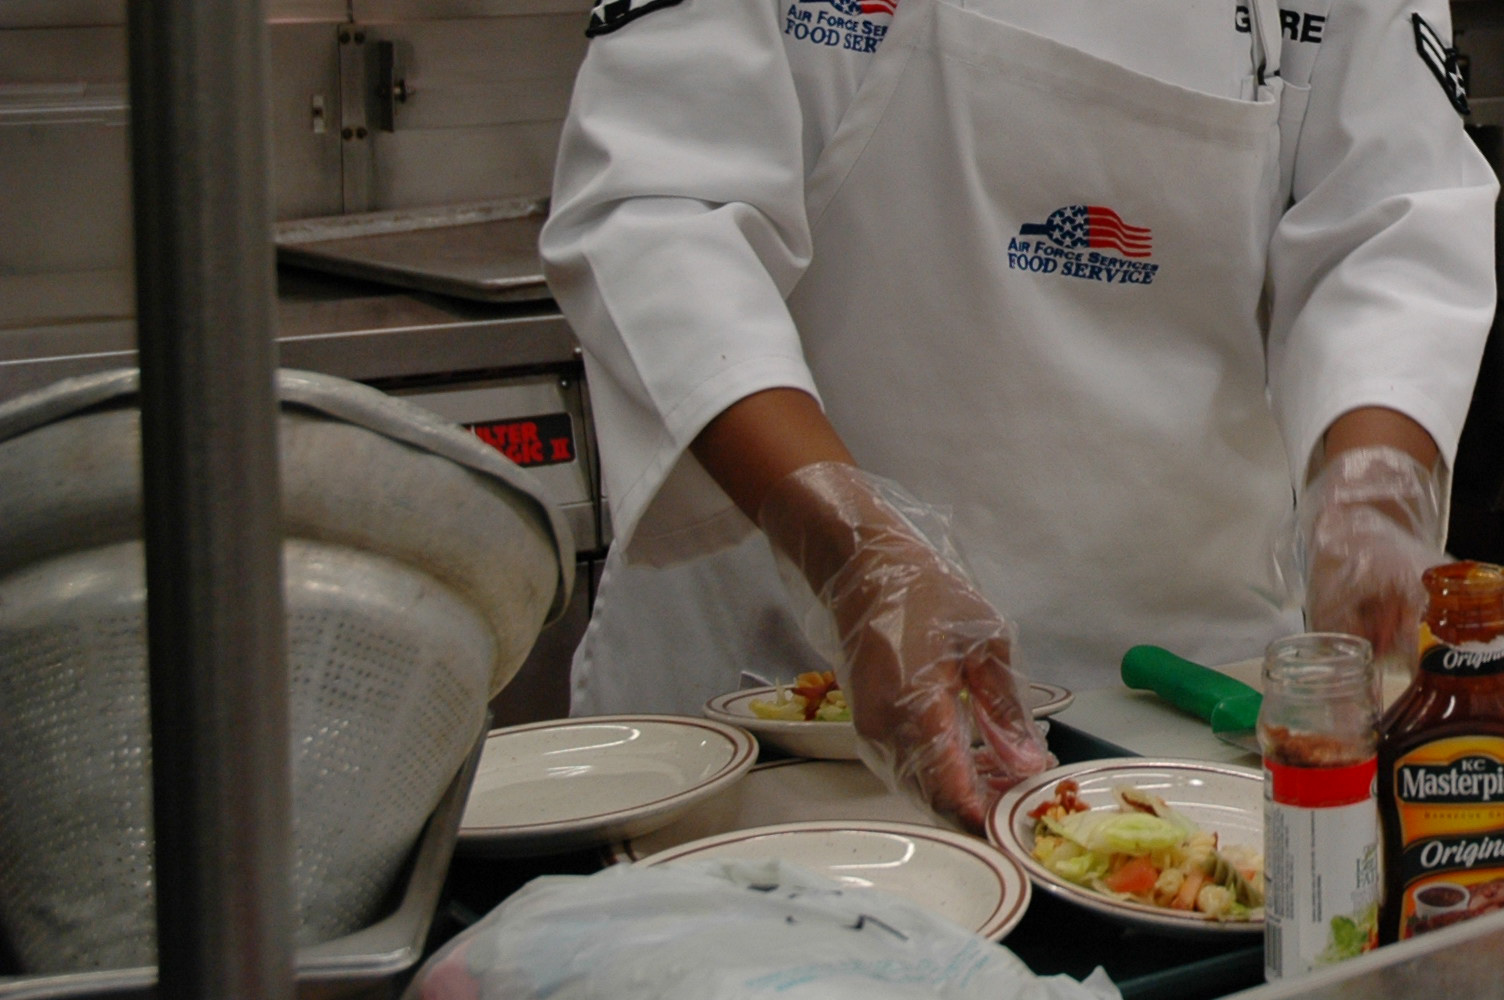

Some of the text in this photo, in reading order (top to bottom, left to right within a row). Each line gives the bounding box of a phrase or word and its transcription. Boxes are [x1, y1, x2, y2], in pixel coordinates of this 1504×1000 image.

[788, 4, 812, 23] AIR
[817, 10, 859, 32] FORCE
[784, 18, 884, 53] FOOD SER
[1007, 237, 1158, 272] AIR FORCE SERVICES
[1007, 252, 1156, 285] FOOD SERVICE
[1461, 758, 1486, 771] KC
